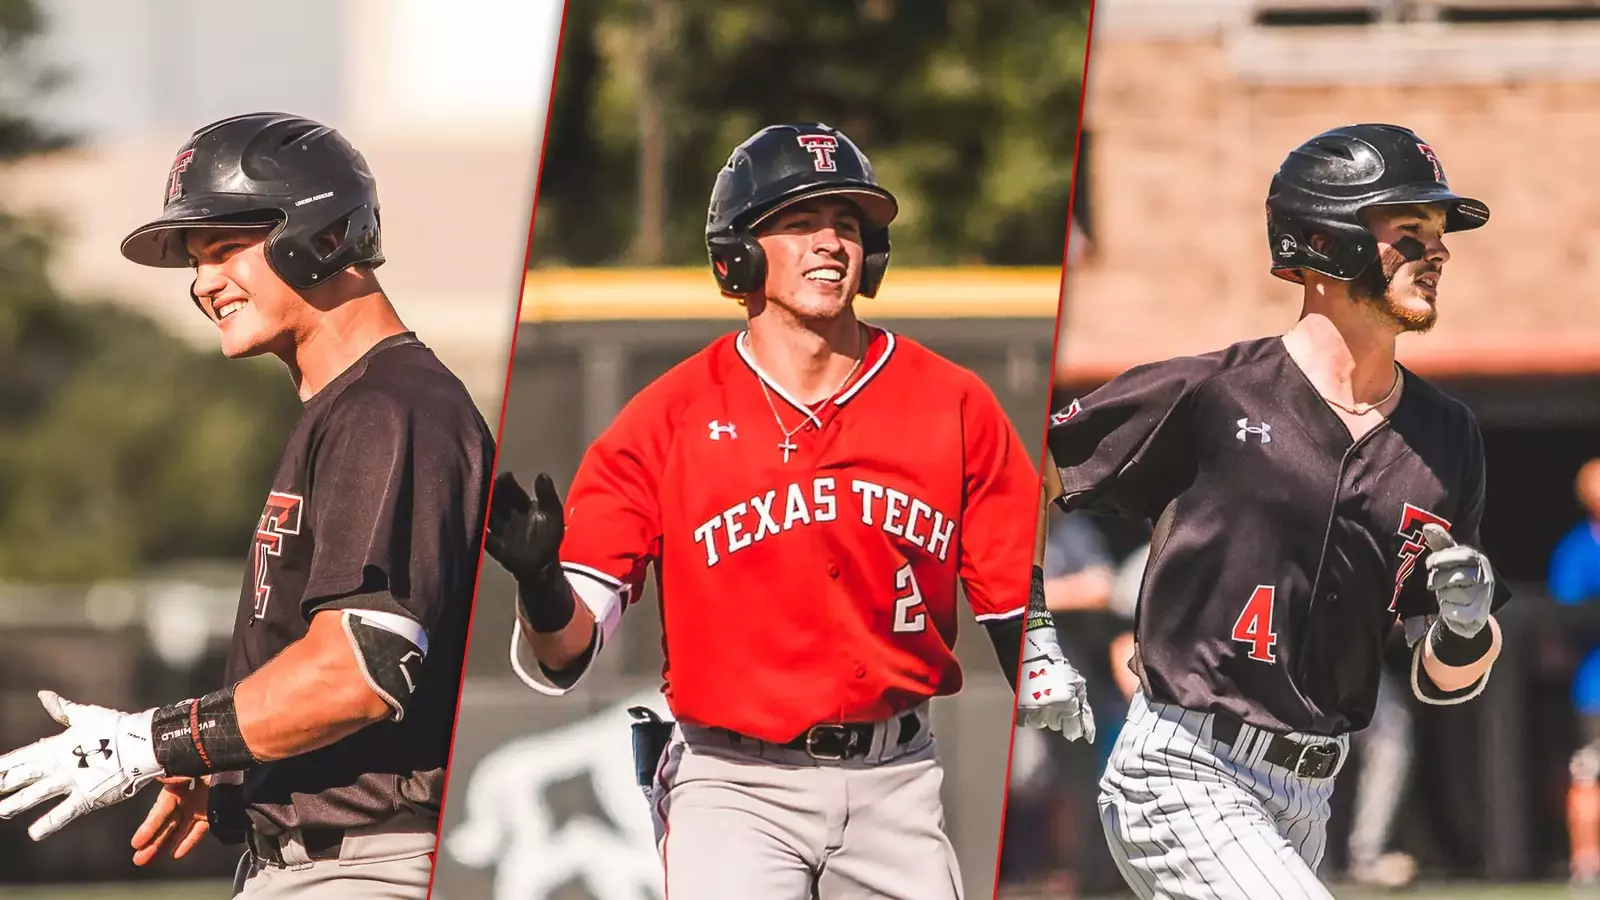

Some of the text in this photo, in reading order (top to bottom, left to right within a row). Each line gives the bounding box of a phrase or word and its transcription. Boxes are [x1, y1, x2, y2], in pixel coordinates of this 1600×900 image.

[693, 476, 957, 568] TEXAS TECH
[892, 562, 927, 634] 2
[1231, 584, 1278, 664] 4
